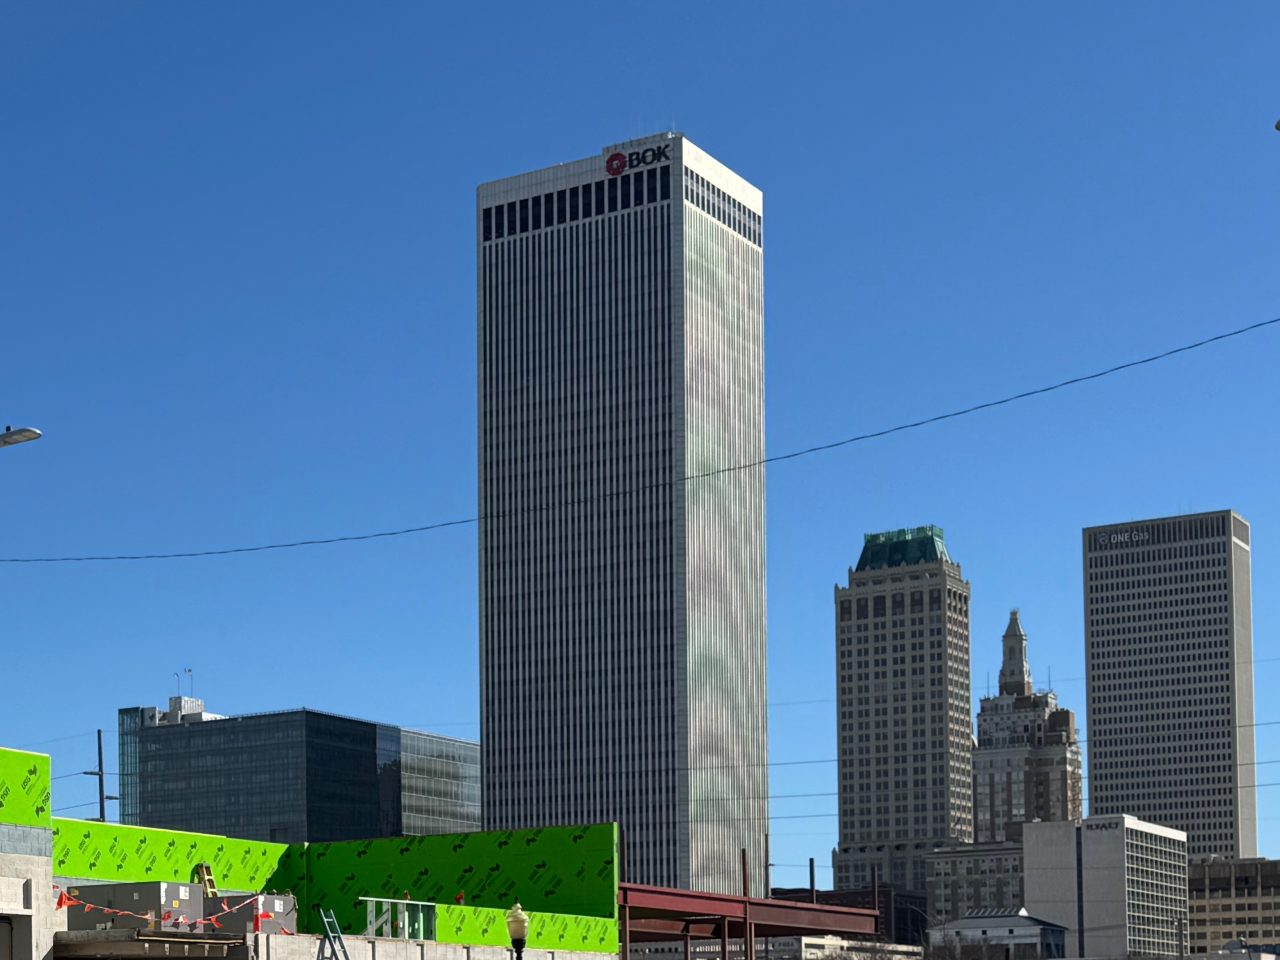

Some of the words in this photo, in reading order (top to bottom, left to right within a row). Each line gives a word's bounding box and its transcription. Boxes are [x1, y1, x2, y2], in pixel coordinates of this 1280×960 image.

[629, 145, 670, 168] BOK
[1111, 532, 1130, 543] ONE
[1132, 531, 1149, 542] Gas
[1087, 822, 1119, 831] HYATT
